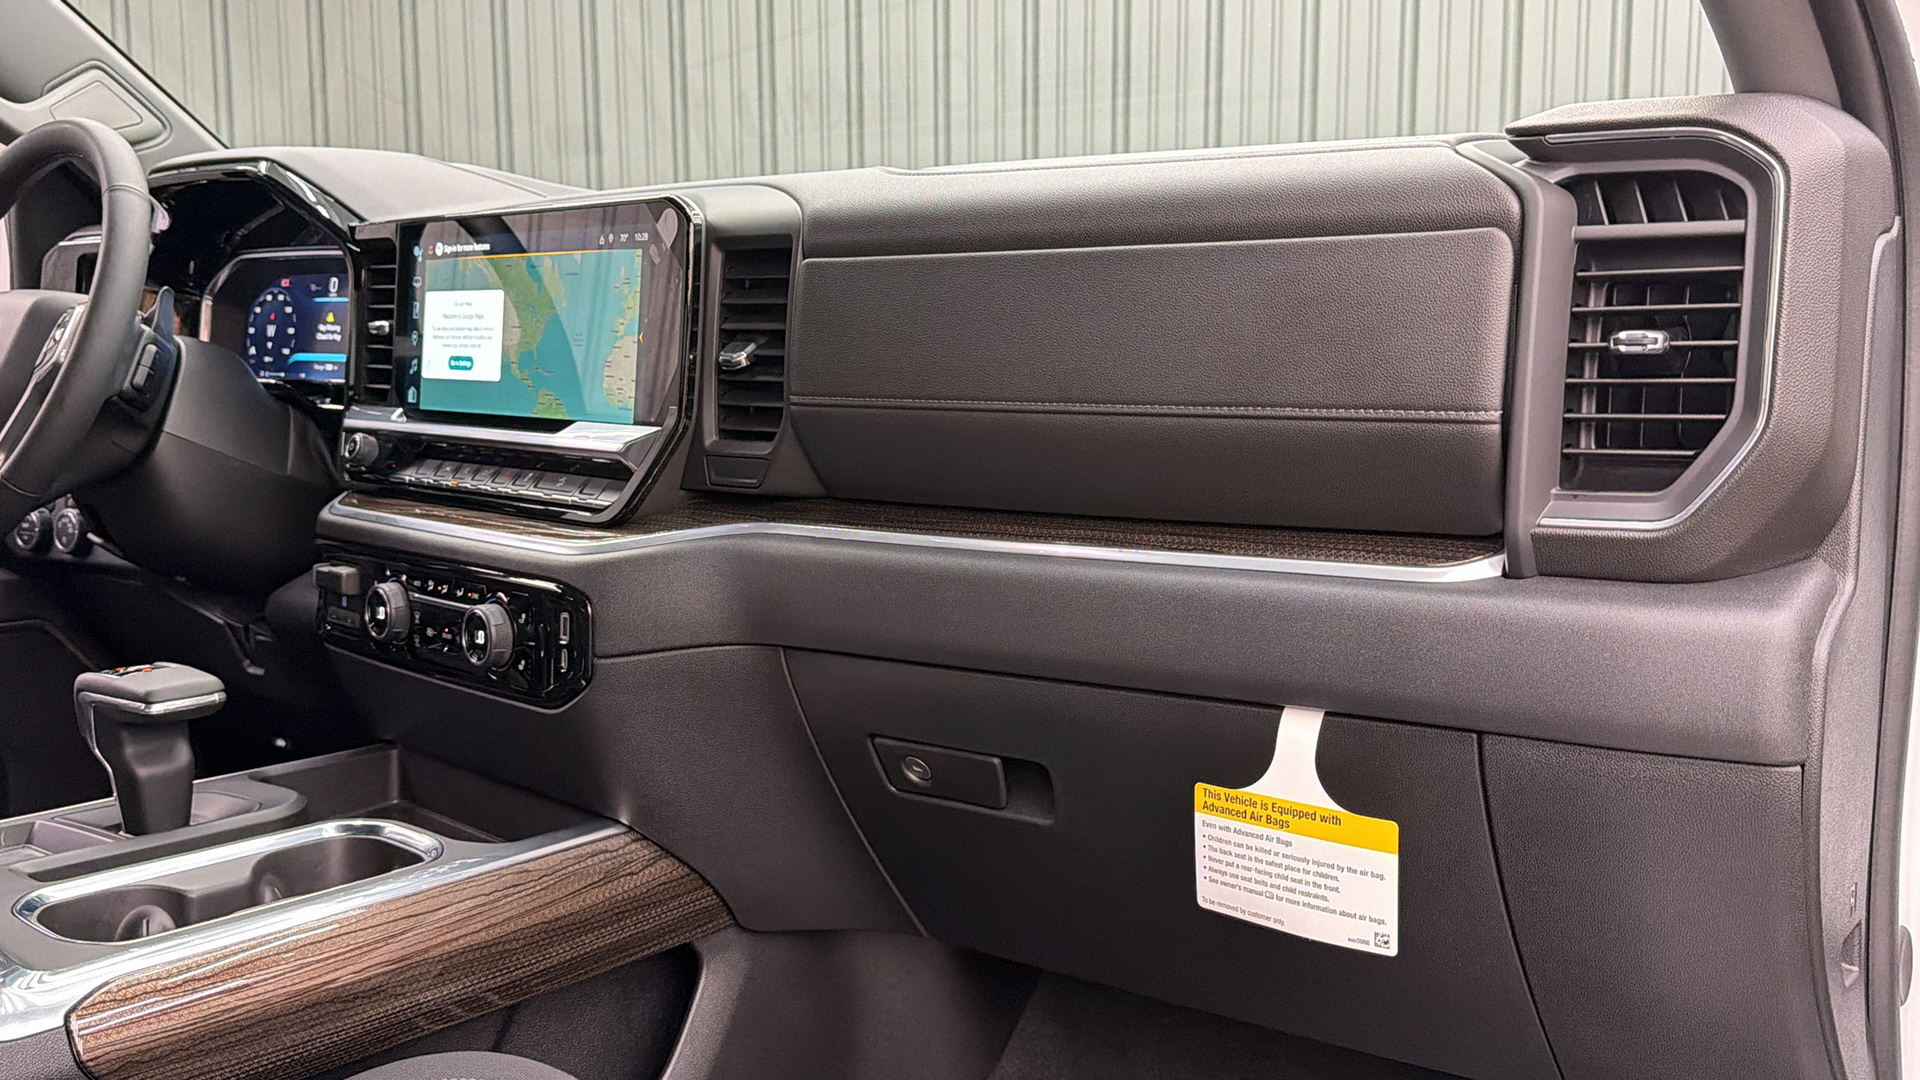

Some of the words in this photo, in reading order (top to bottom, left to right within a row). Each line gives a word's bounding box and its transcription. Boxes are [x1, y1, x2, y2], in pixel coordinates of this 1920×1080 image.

[329, 276, 339, 293] 0
[266, 324, 277, 338] W
[1202, 787, 1222, 801] This
[1224, 792, 1258, 809] Vehicle
[1260, 800, 1269, 811] is
[1271, 802, 1317, 821] Equipped
[1319, 813, 1342, 826] with
[1202, 801, 1247, 819] Advanced
[1249, 811, 1263, 822] Air
[1265, 814, 1291, 829] Bags
[1202, 820, 1217, 830] Even
[1218, 824, 1231, 833] with
[1233, 827, 1264, 841] Advanced
[1265, 834, 1275, 843] Air
[1276, 836, 1293, 848] Bags
[1207, 834, 1232, 846] Children
[1233, 841, 1244, 849] can
[1245, 843, 1254, 851] be
[1254, 845, 1272, 856] killed
[1281, 852, 1310, 865] seriously
[1312, 858, 1335, 870] injured
[1336, 863, 1346, 873] by
[1346, 866, 1358, 875] the
[1359, 868, 1369, 877] air
[1370, 870, 1387, 881] bag.
[1207, 844, 1218, 853] The
[1219, 847, 1233, 857] back
[1234, 852, 1246, 860] seat
[1254, 856, 1264, 864] the
[1265, 859, 1284, 869] safest
[1284, 864, 1301, 873] place
[1302, 868, 1311, 876] for
[1312, 870, 1340, 882] children.
[1208, 855, 1224, 865] Never
[1225, 860, 1235, 868] put
[1241, 864, 1273, 879] rear-facing
[1274, 872, 1289, 881] child
[1290, 876, 1303, 885] seat
[1304, 879, 1311, 887] in
[1312, 881, 1322, 889] the
[1323, 883, 1341, 894] front.
[1208, 865, 1228, 877] Always
[1229, 871, 1239, 879] use
[1240, 874, 1252, 883] seat
[1254, 877, 1268, 887] belts
[1269, 882, 1281, 890] and
[1282, 885, 1297, 894] child
[1298, 889, 1330, 902] restraints.
[1208, 875, 1219, 884] See
[1220, 880, 1242, 891] owner's
[1243, 886, 1264, 897] manual
[1275, 893, 1284, 902] for
[1285, 897, 1301, 906] more
[1301, 899, 1338, 915] information
[1339, 909, 1357, 919] about
[1368, 915, 1388, 926] bags.
[1201, 895, 1208, 903] To
[1216, 901, 1239, 912] removed
[1240, 906, 1247, 915] by
[1247, 910, 1272, 922] customer
[1273, 917, 1286, 927] only.
